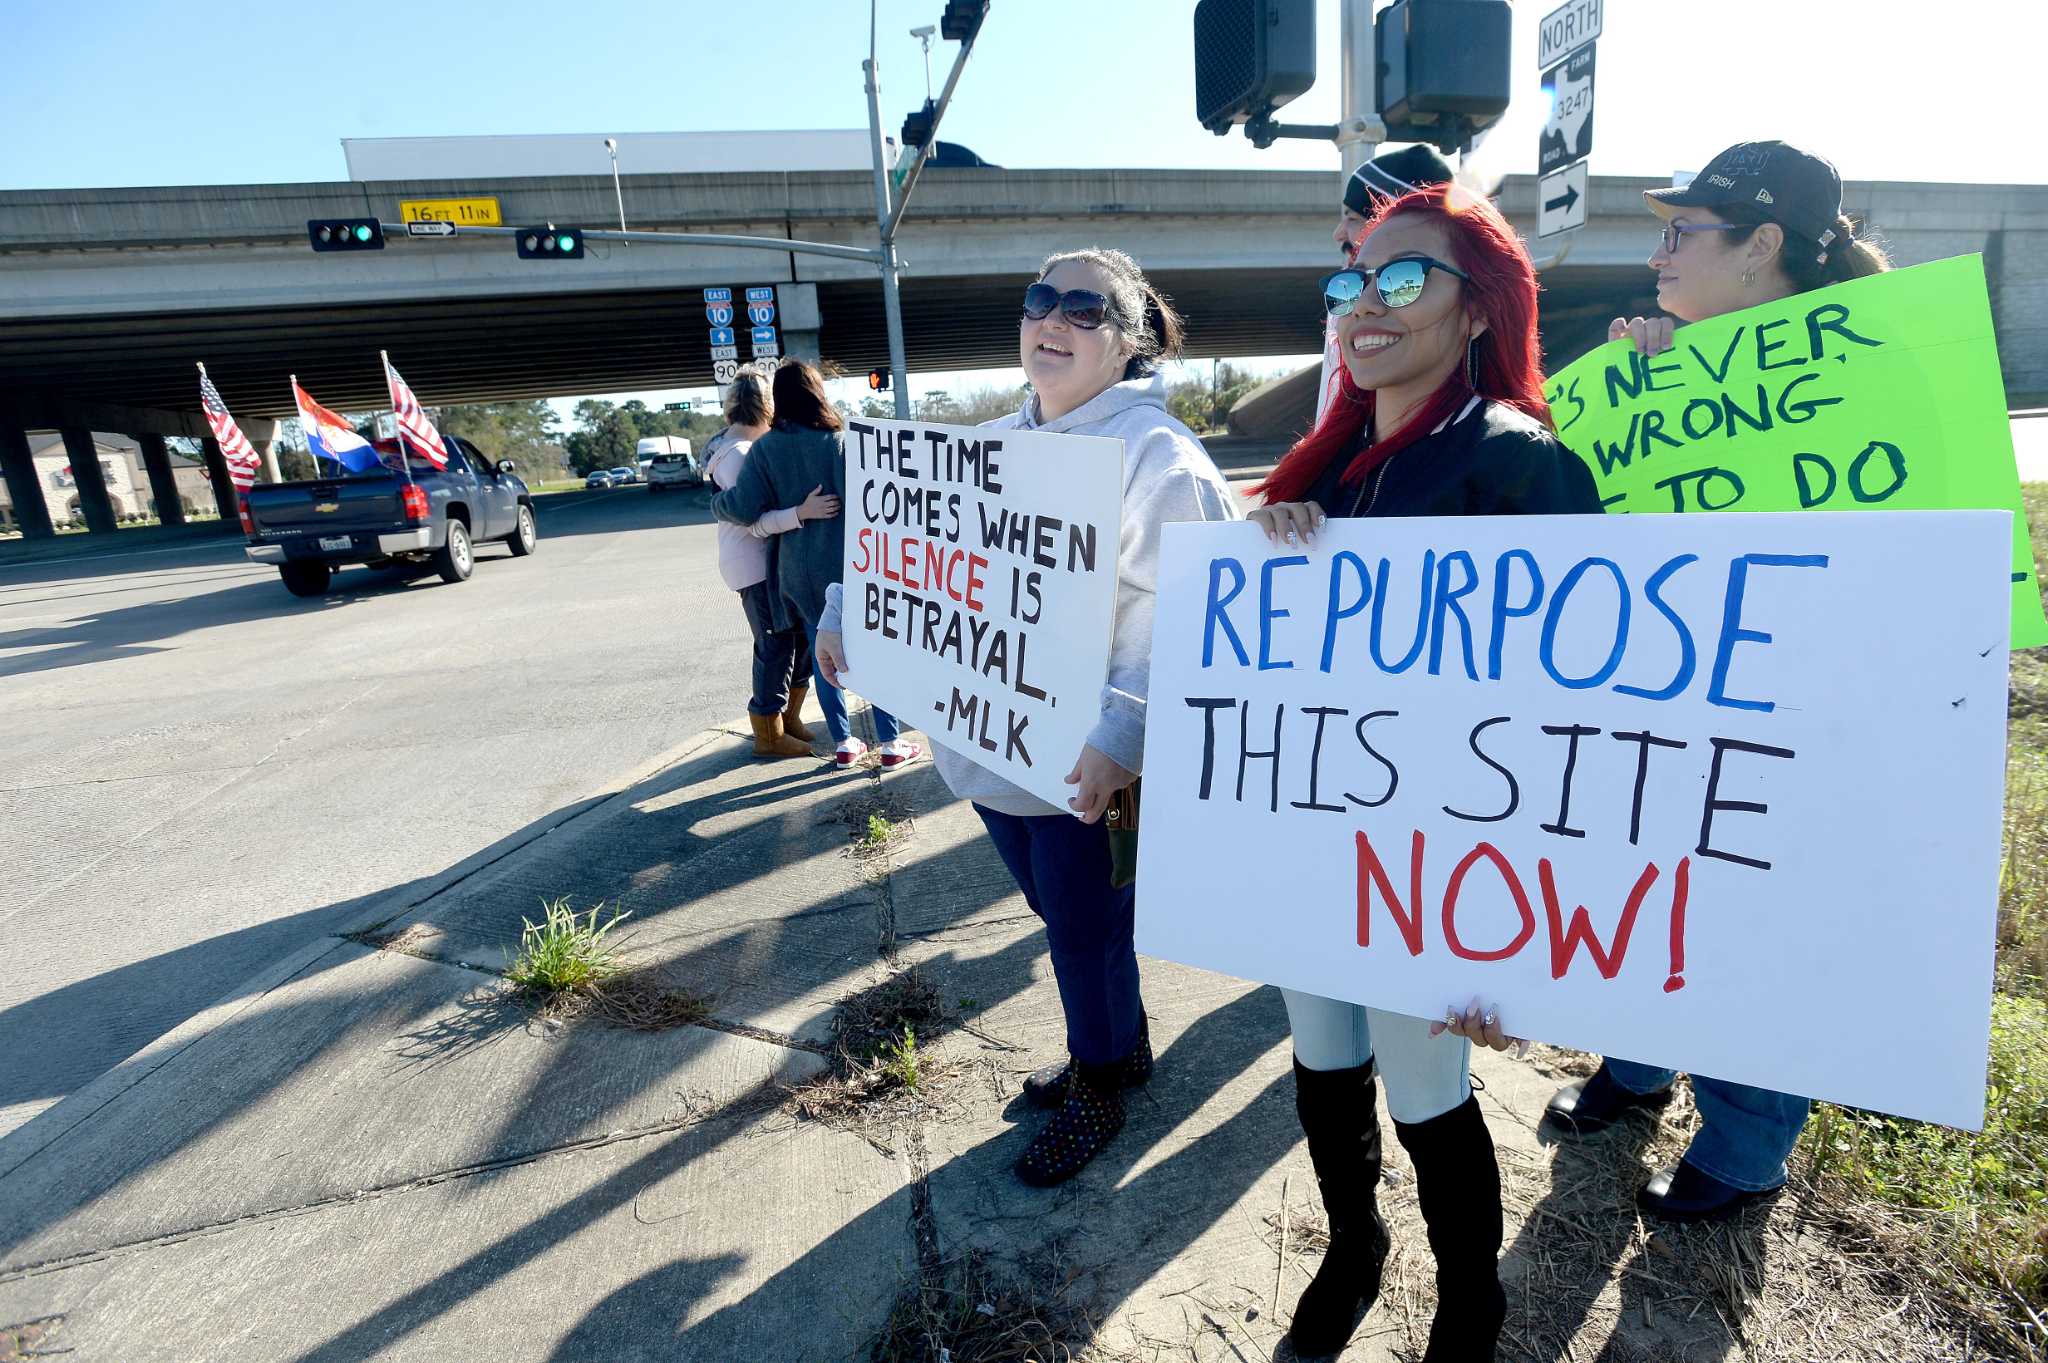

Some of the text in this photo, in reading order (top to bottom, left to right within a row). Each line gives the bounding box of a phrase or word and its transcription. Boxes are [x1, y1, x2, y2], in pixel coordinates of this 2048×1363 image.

[1542, 0, 1598, 57] NORTH
[1557, 86, 1589, 120] 3247
[1706, 174, 1736, 190] IRISH
[708, 291, 728, 300] EAST
[713, 307, 728, 323] 10
[750, 290, 769, 299] WEST
[754, 307, 769, 322] 10
[715, 349, 733, 358] EAST
[716, 364, 737, 378] 90
[1593, 373, 1844, 478] WRONG
[849, 421, 1003, 494] THE TIME
[1654, 440, 1908, 513] TO DO
[862, 479, 1097, 572] COMES WHEN
[852, 528, 1043, 625] SILENCE IS
[1202, 548, 1830, 712] REPURPOSE
[1185, 697, 1796, 870] THIS SITE
[1355, 829, 1690, 993] NOW!
